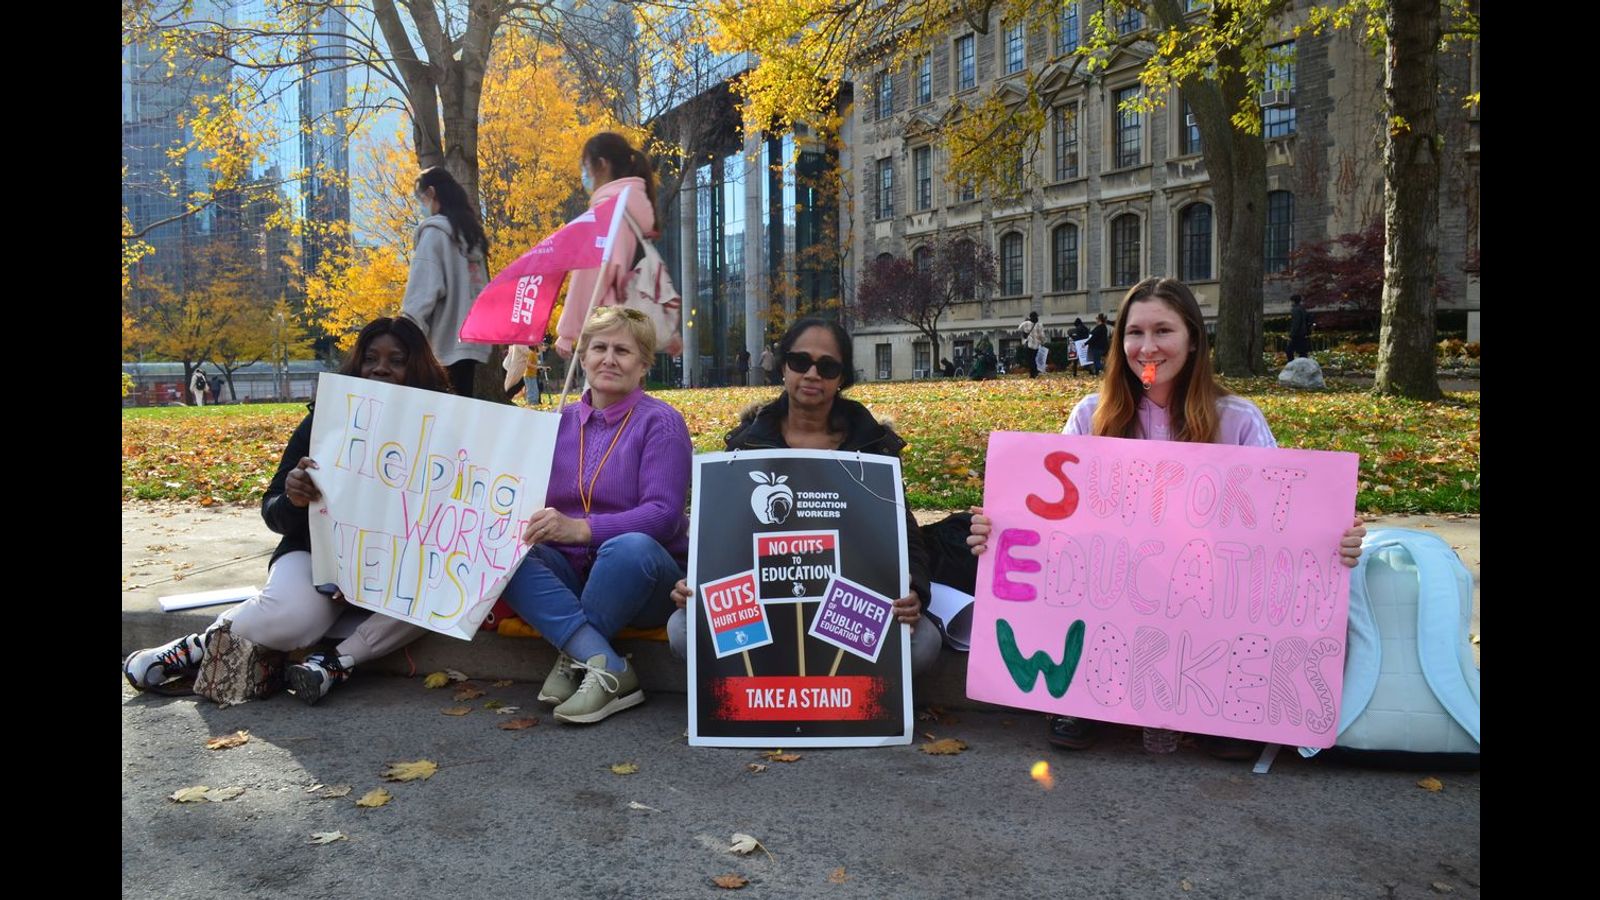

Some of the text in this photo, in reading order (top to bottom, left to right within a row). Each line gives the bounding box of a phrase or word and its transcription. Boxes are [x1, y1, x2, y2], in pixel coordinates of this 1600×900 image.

[520, 275, 543, 325] SCFP
[336, 394, 527, 549] Helping
[796, 492, 840, 500] TORONTO
[1025, 450, 1307, 533] SUPPORT
[796, 501, 847, 509] EDUCATION
[796, 510, 841, 518] WORKERS
[768, 539, 824, 556] NO CUTS
[792, 556, 802, 564] TO
[761, 565, 833, 582] EDUCATION
[992, 527, 1341, 632] EDUCATION
[709, 582, 755, 612] CUTS
[828, 602, 838, 610] OF
[831, 587, 886, 623] POWER
[713, 606, 760, 628] HURT KIDS
[823, 610, 863, 634] PUBLIC
[819, 621, 859, 643] EDUCATION
[996, 618, 1341, 735] WORKERS
[746, 688, 852, 708] TAKE A STAND
